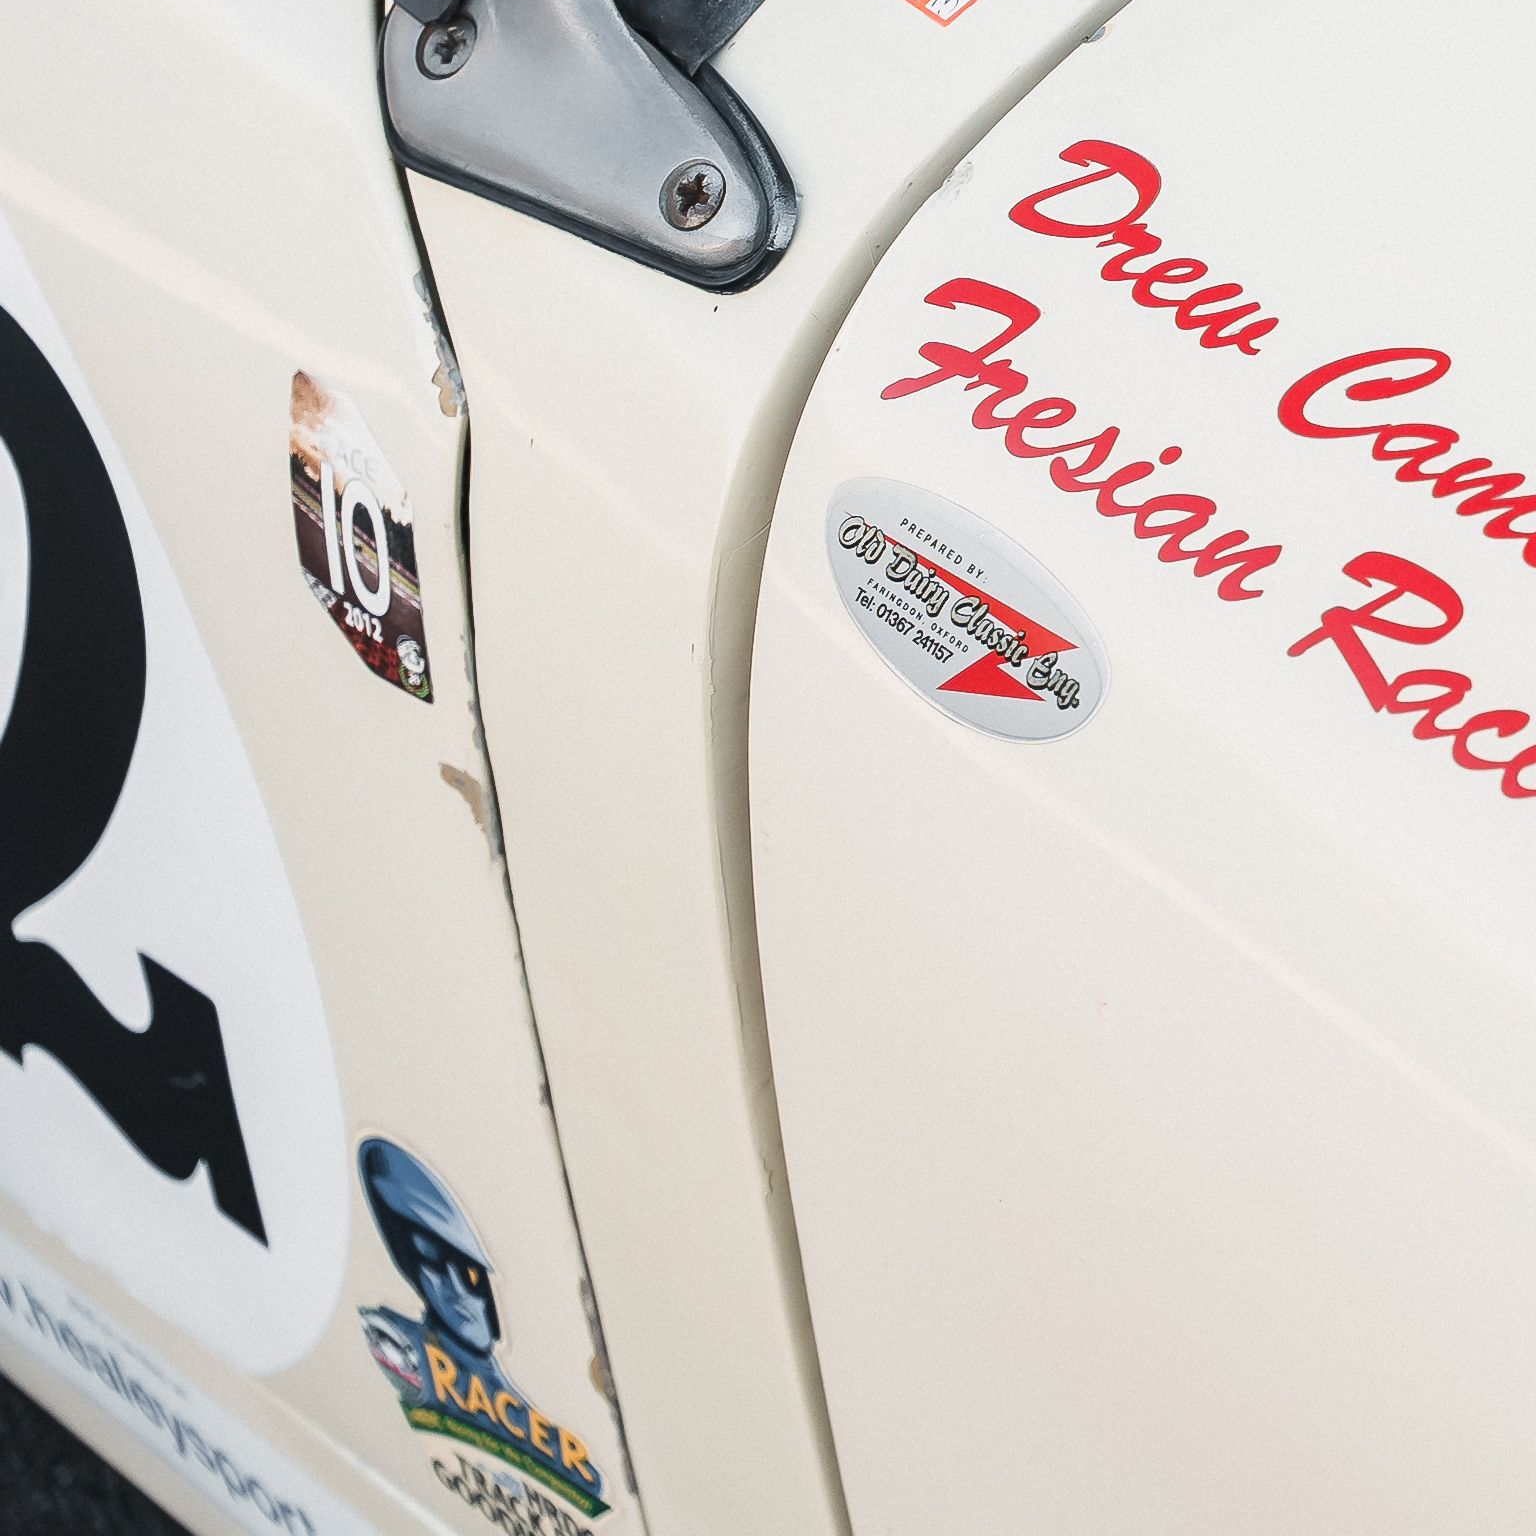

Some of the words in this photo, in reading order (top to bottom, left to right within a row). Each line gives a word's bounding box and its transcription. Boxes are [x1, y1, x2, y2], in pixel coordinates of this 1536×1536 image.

[1008, 139, 1279, 356] Drew
[880, 277, 1283, 603] Fresian
[320, 459, 392, 617] 10
[899, 517, 963, 565] PREPARED
[343, 600, 384, 644] 2012
[838, 515, 887, 565] Old
[885, 541, 950, 618] Dairy
[950, 595, 1030, 667] Classic
[1026, 651, 1081, 710] Eng.
[855, 586, 876, 612] Tel:
[876, 602, 916, 636] 01367
[911, 629, 955, 664] 241157
[930, 622, 969, 654] OXFORD
[424, 1342, 595, 1484] RACER
